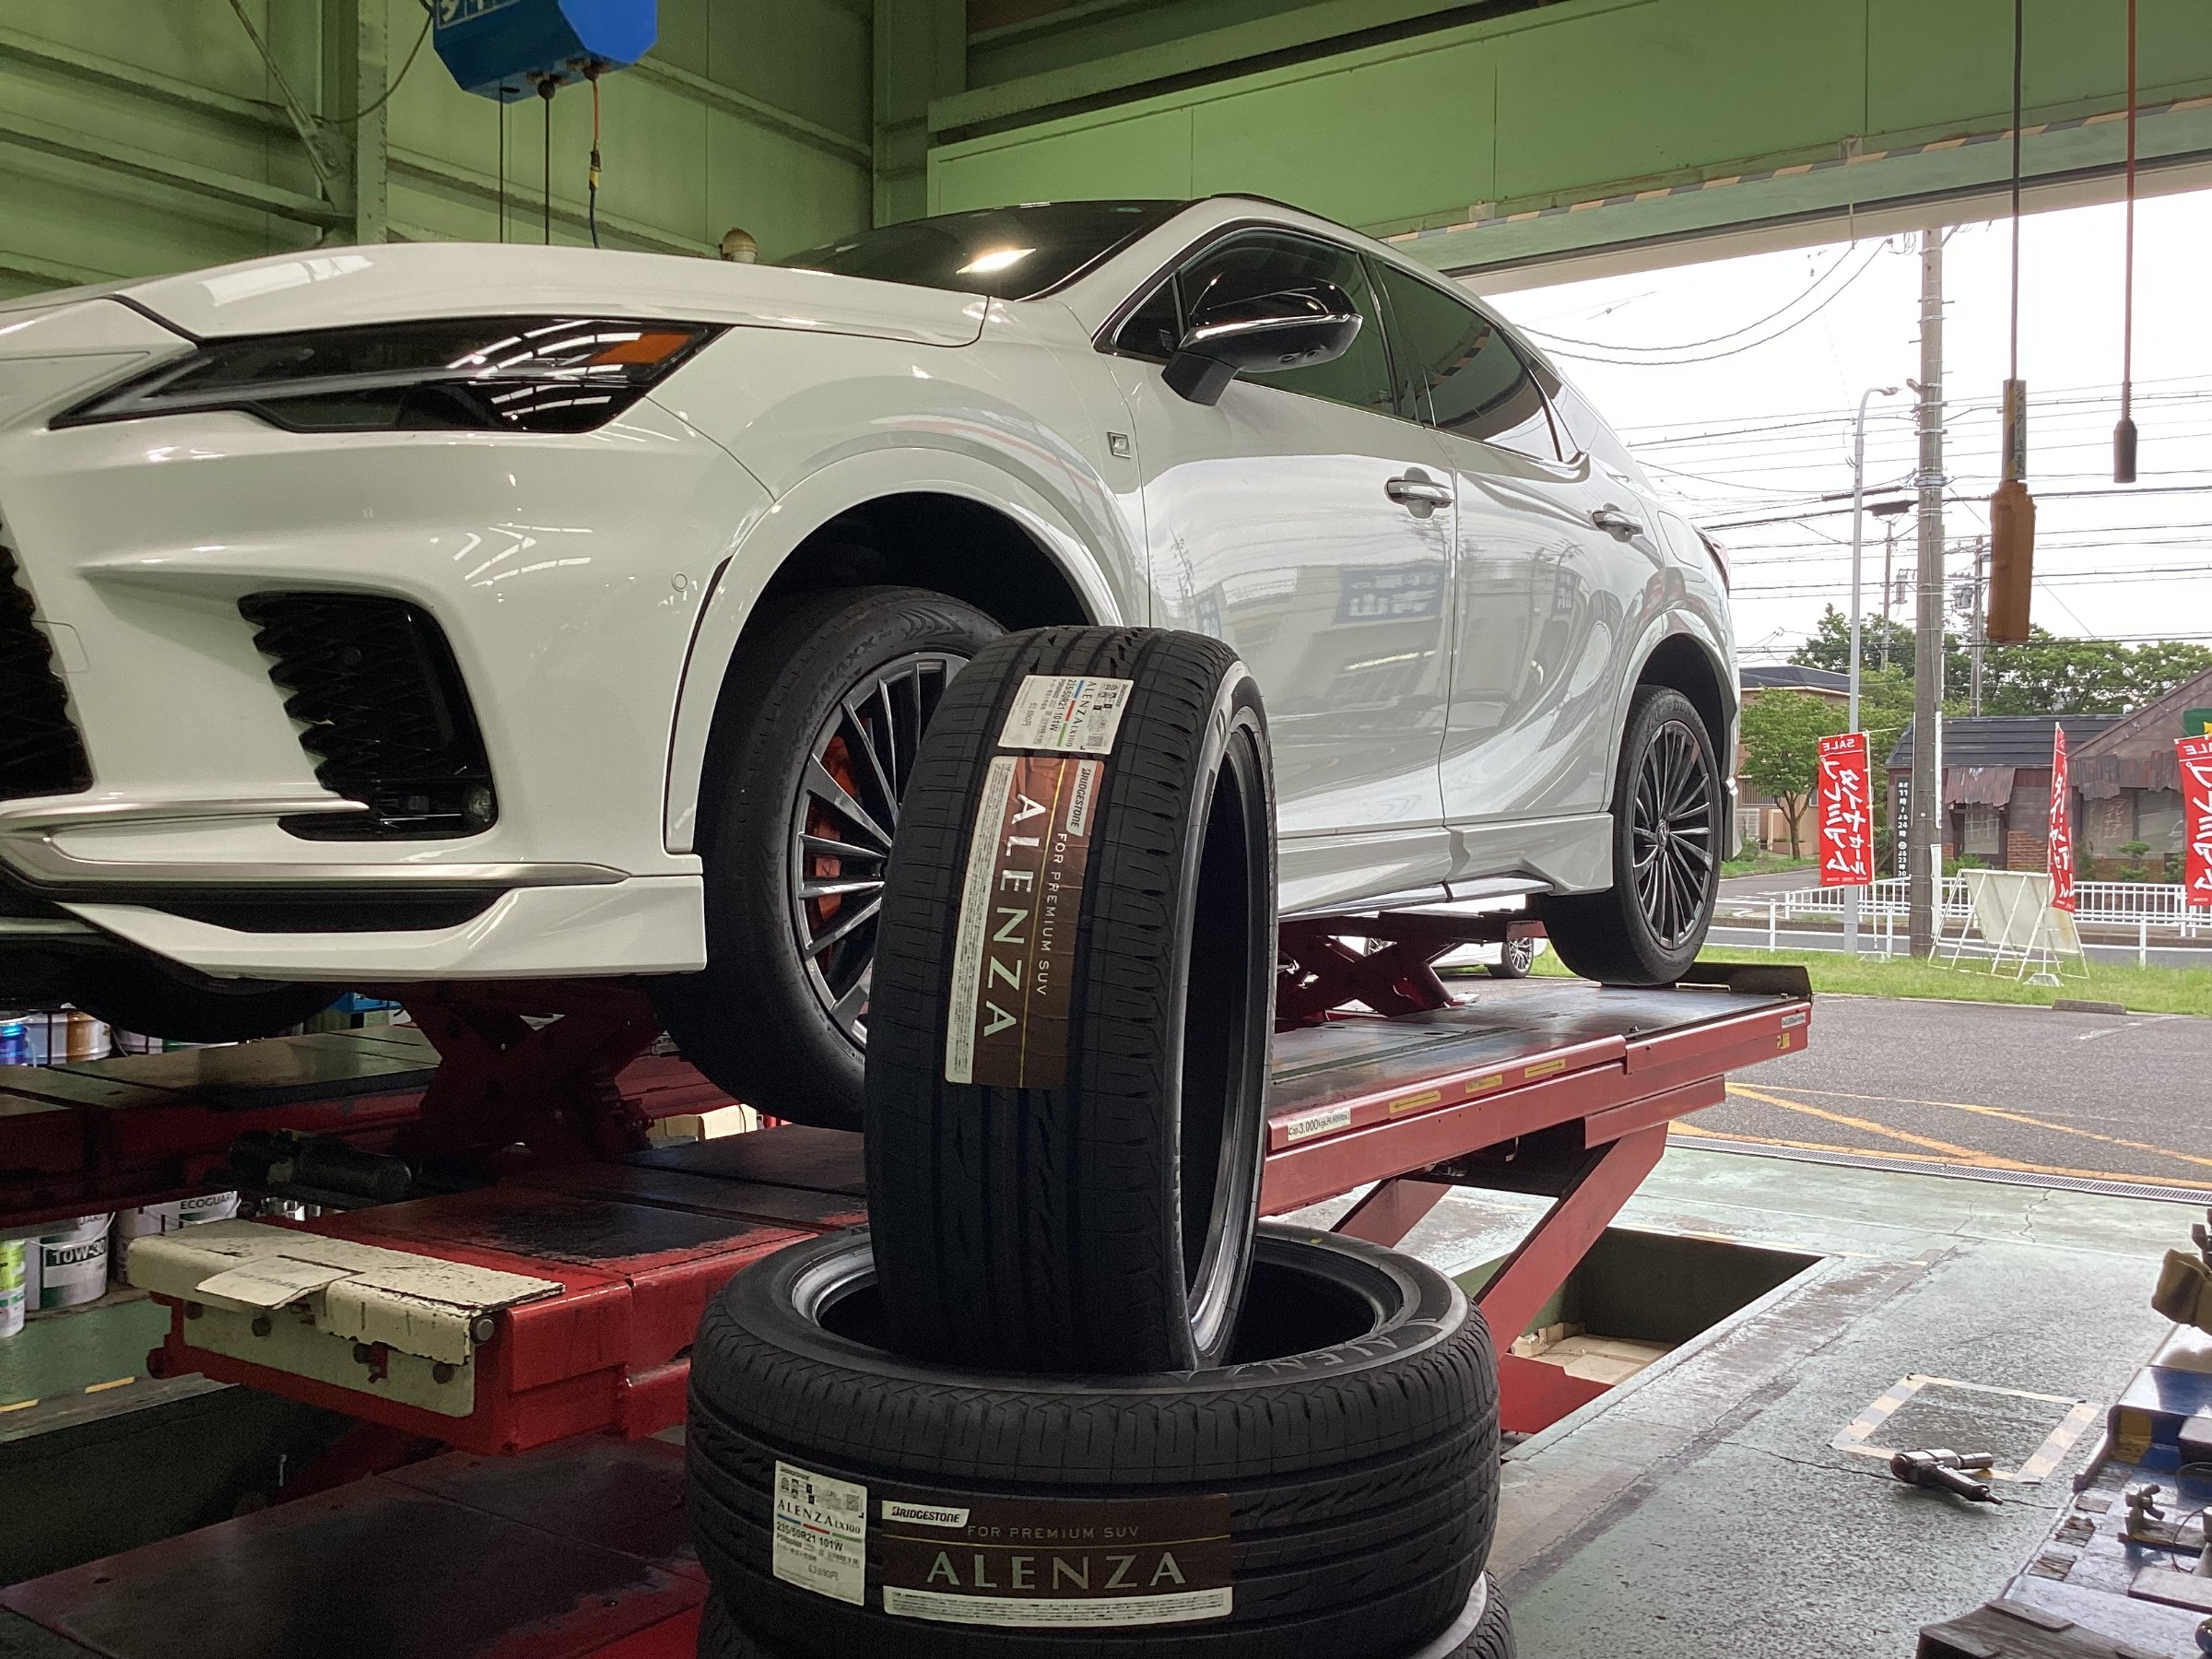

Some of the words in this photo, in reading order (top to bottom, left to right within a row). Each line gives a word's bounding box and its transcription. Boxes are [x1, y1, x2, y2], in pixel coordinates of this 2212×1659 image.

[1073, 681, 1097, 724] ALENZA
[1050, 712, 1064, 732] 101W
[1065, 725, 1078, 747] LX100
[1070, 767, 1091, 828] BRIDGESTONE
[1053, 832, 1068, 865] FOR
[983, 794, 1047, 1038] ALENZA
[1041, 871, 1062, 951] PREMIUM
[1035, 960, 1051, 996] SUV
[53, 1241, 106, 1265] 10W-30
[777, 1499, 833, 1527] ALENZA
[834, 1523, 861, 1535] LX100
[891, 1505, 960, 1524] BRIDGESTONE
[819, 1536, 843, 1552] 101W
[967, 1525, 1000, 1539] FOR
[1009, 1526, 1095, 1540] PREMIUM
[1104, 1524, 1140, 1539] SUV
[926, 1551, 1186, 1590] ALENZA
